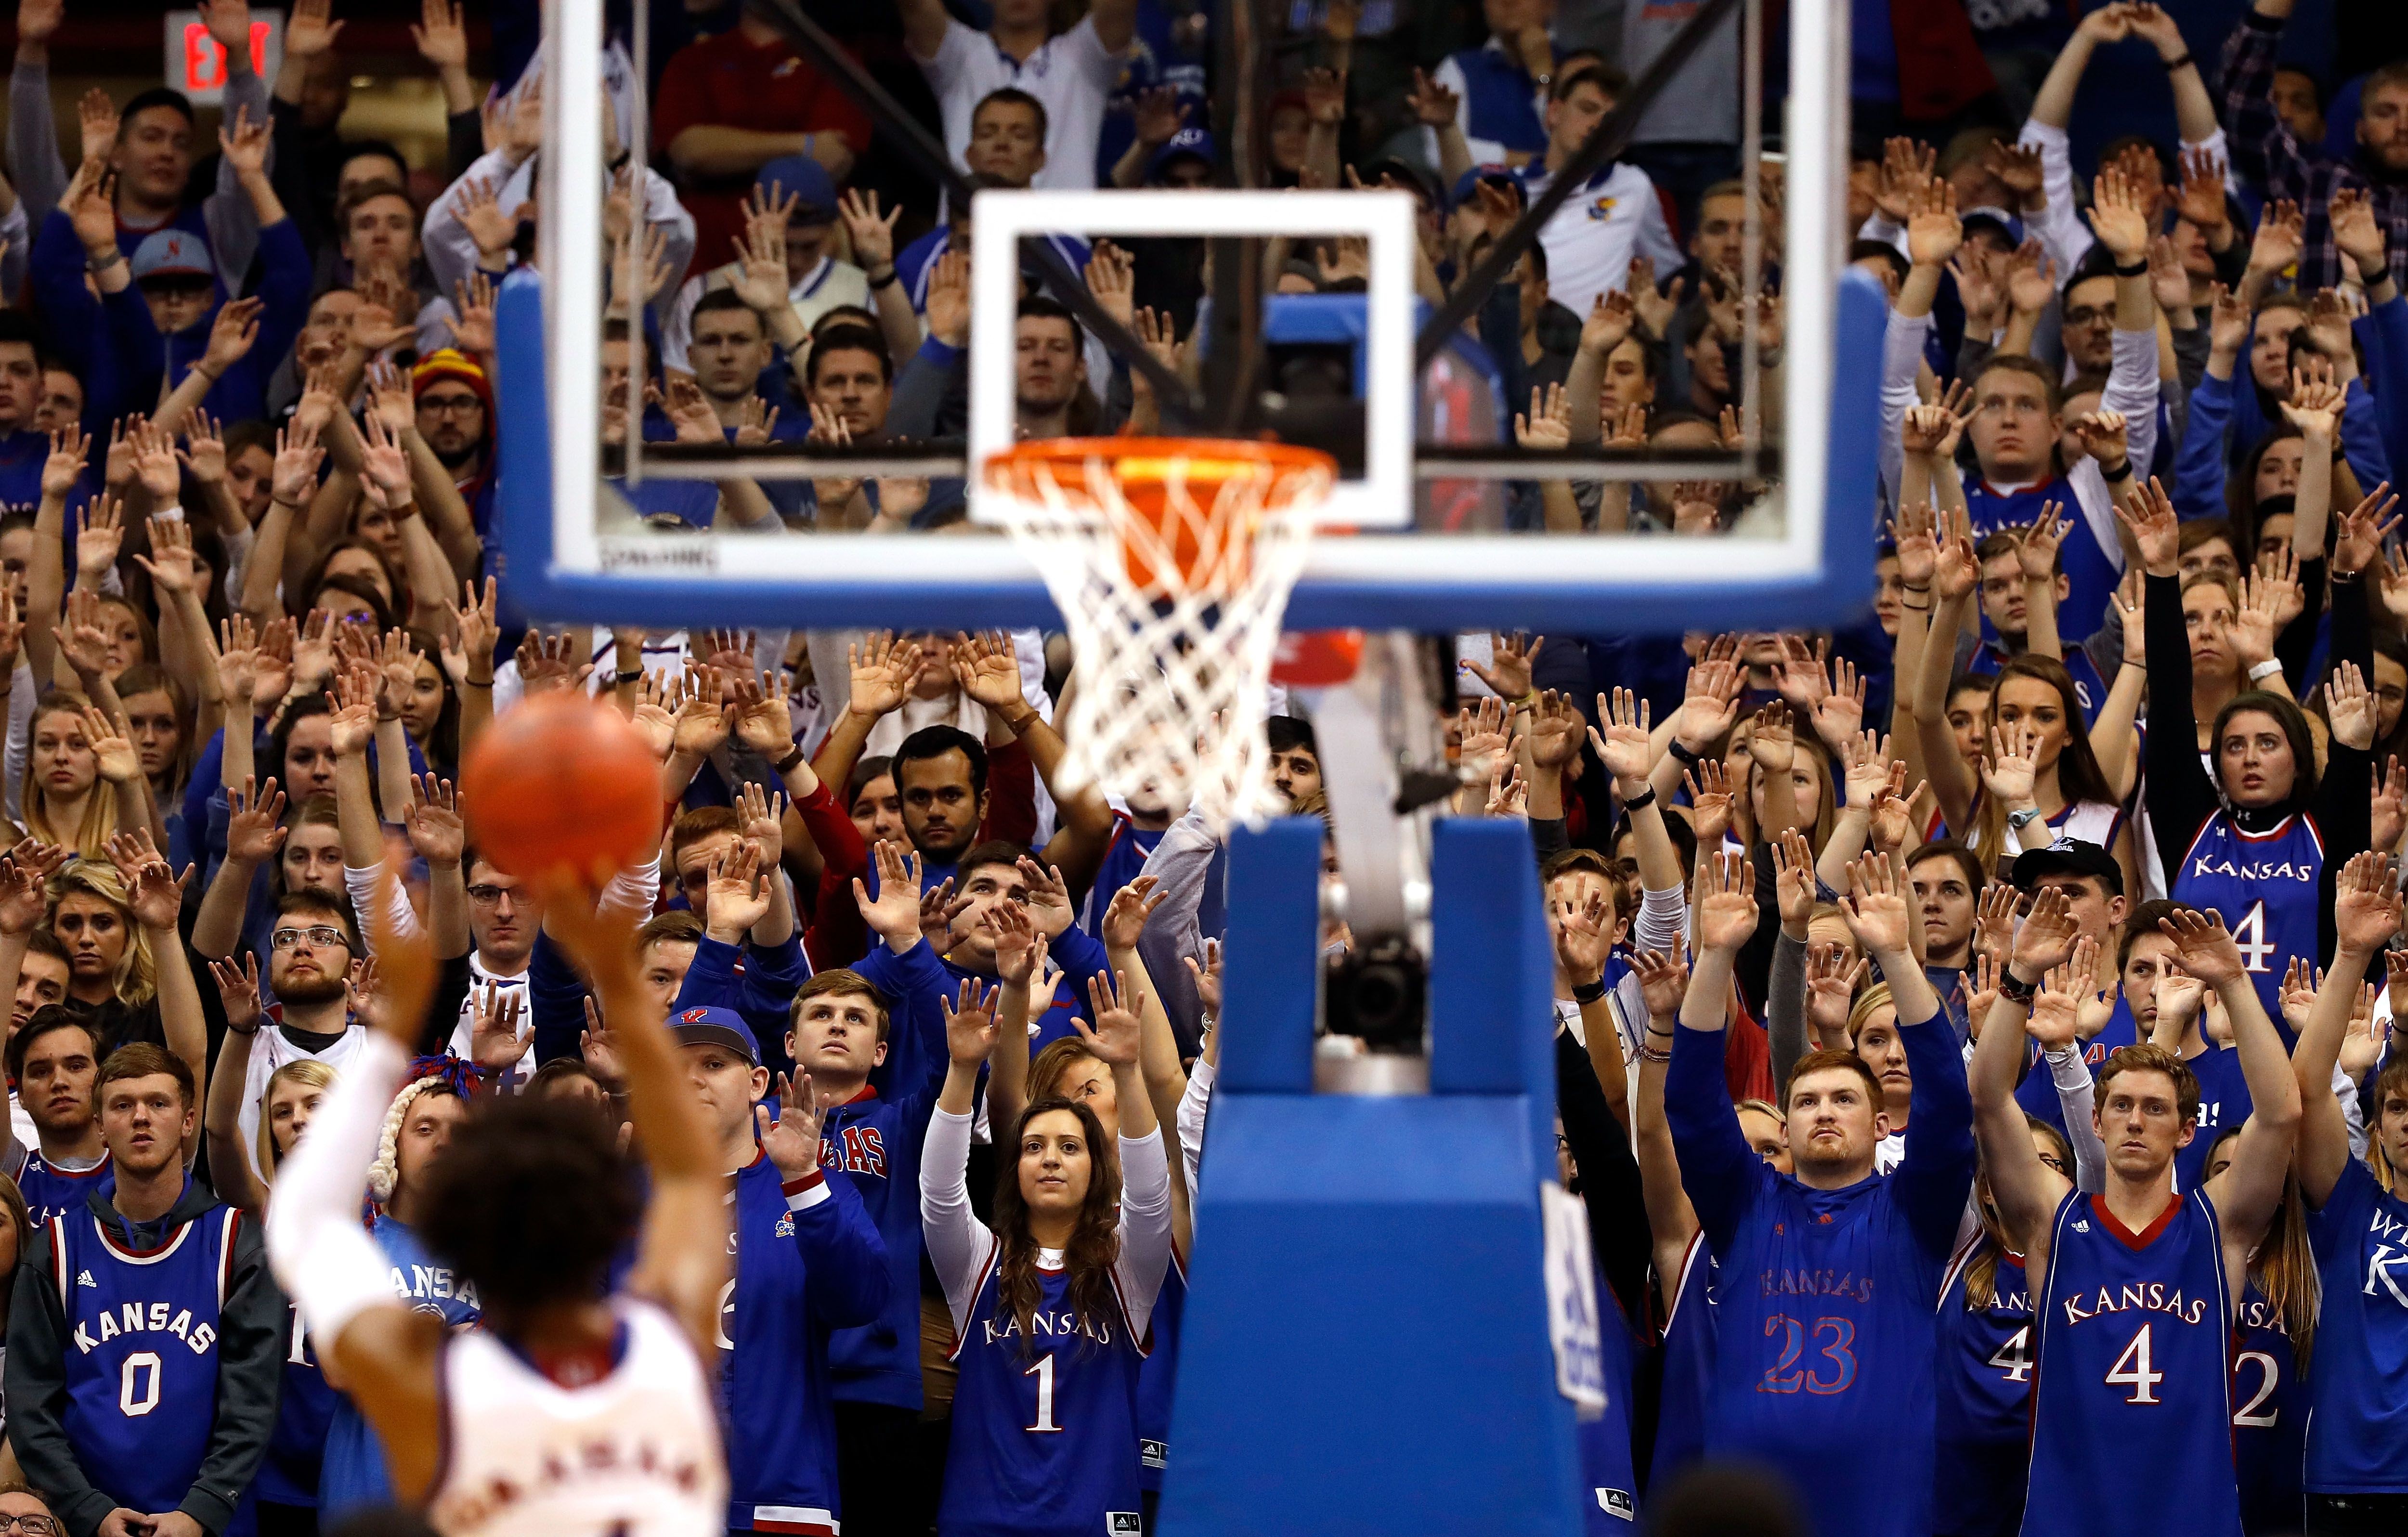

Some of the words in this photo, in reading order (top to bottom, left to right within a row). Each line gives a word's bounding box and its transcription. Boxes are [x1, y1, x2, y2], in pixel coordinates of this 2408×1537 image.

[183, 21, 272, 90] ET
[2193, 854, 2313, 883] KANSAS
[2231, 898, 2277, 973] 4
[77, 1278, 97, 1288] didas
[388, 1263, 481, 1311] ANSA
[1760, 1268, 1874, 1303] KANSAS
[2062, 1282, 2207, 1325] KANSAS
[74, 1302, 217, 1355] KANSAS
[981, 1310, 1113, 1345] KANSAS
[1756, 1313, 1859, 1395] 23
[1988, 1325, 2034, 1382] 4
[119, 1351, 162, 1417] 0
[2104, 1322, 2164, 1405] 4
[2233, 1351, 2279, 1428] 2
[1024, 1352, 1064, 1433] 1
